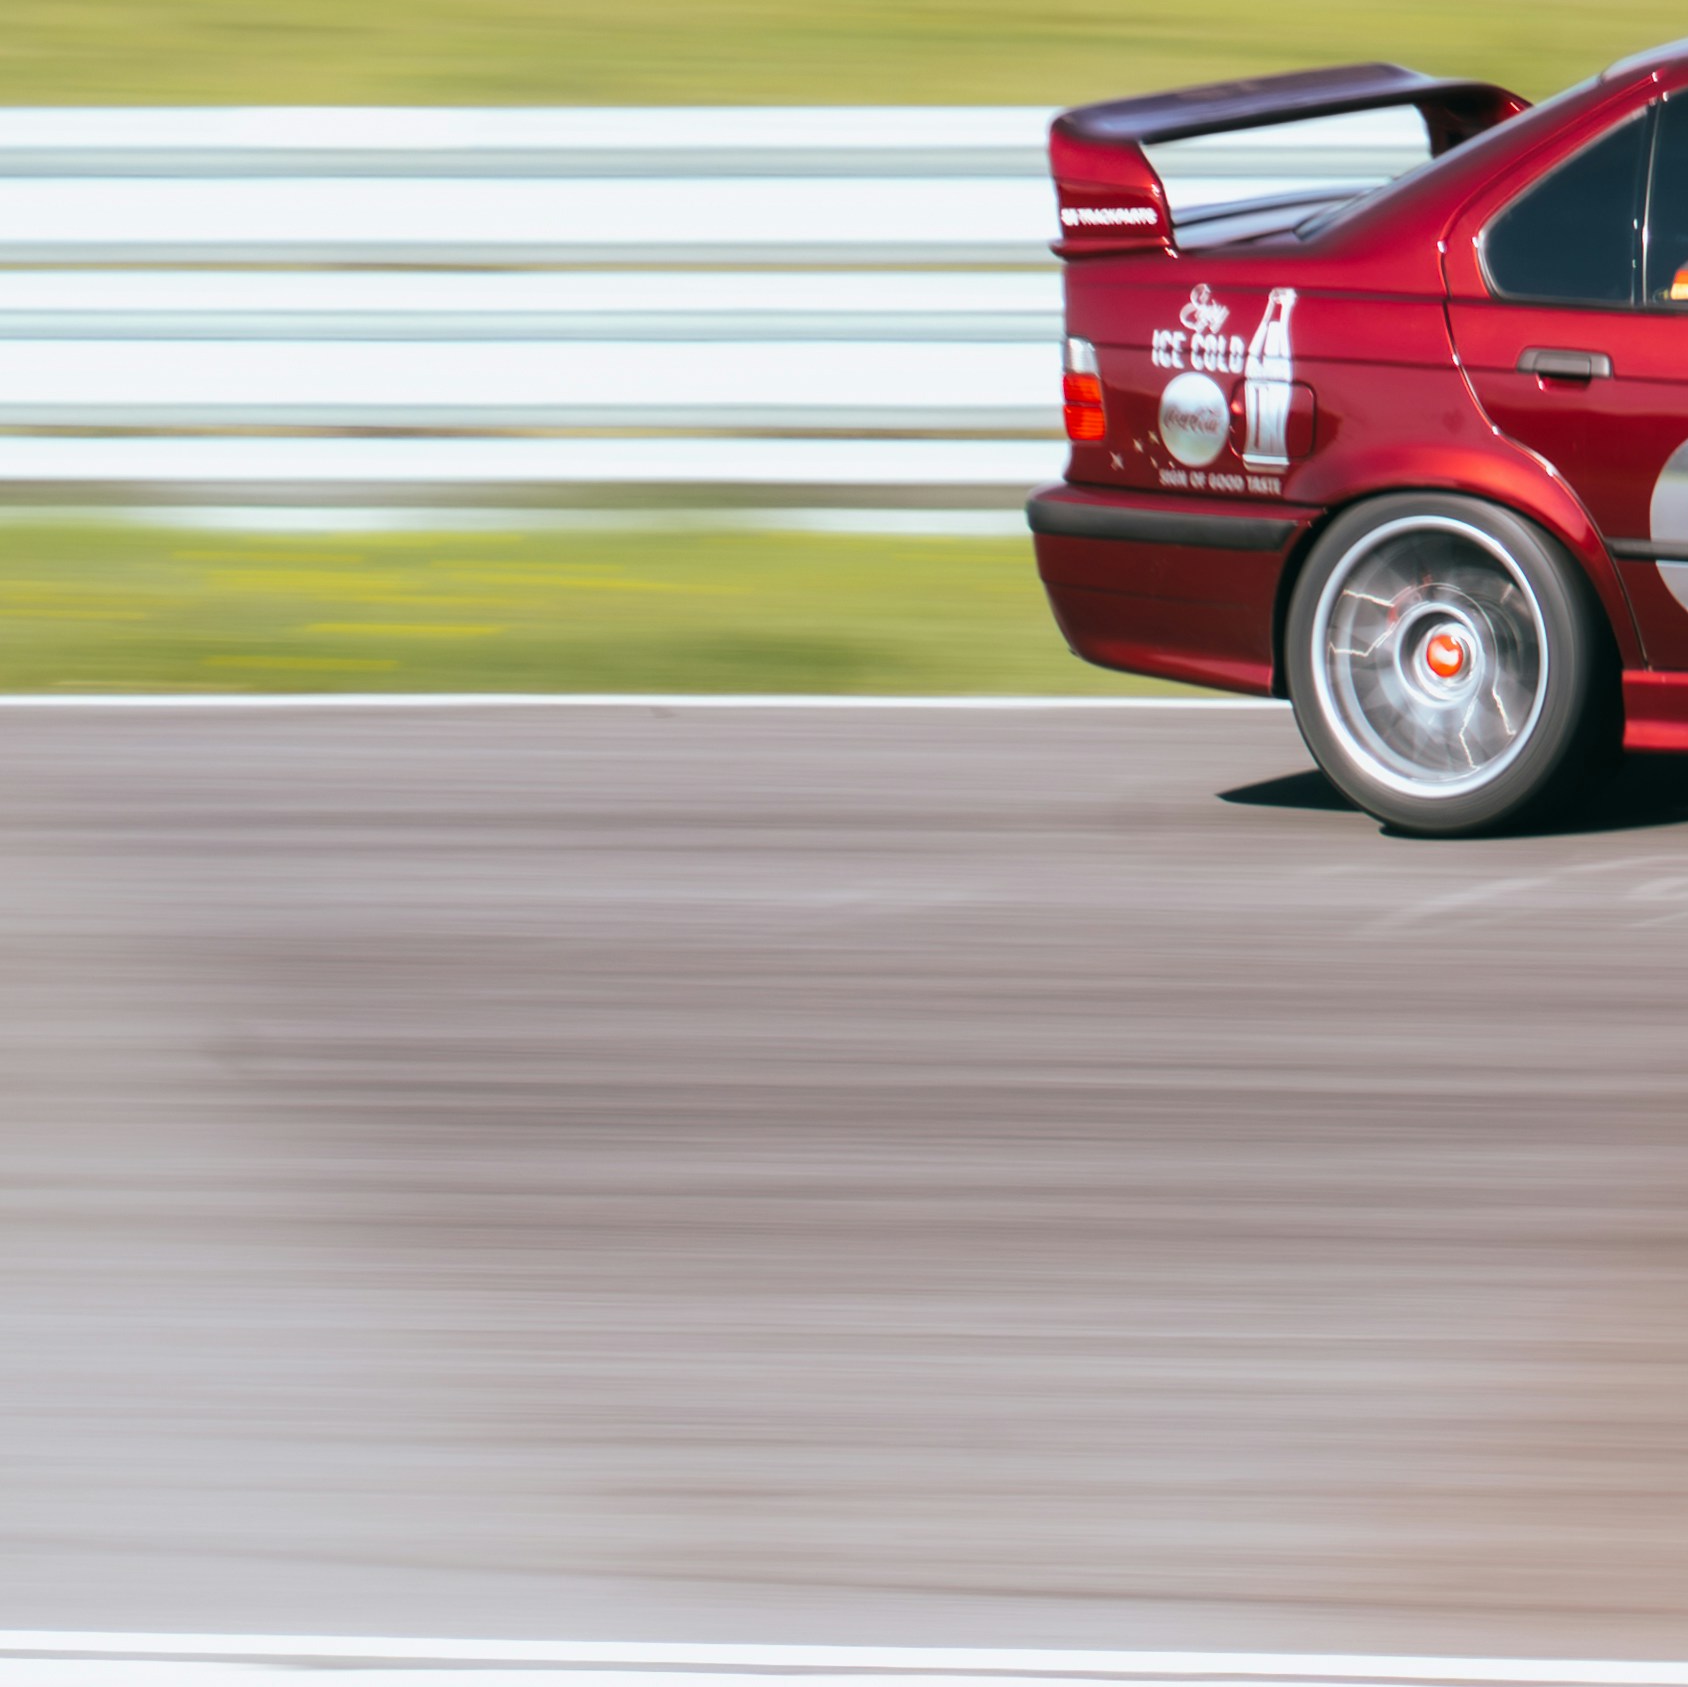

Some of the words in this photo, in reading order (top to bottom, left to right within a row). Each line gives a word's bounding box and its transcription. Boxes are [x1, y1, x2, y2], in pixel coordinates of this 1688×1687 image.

[1151, 328, 1187, 369] ICE
[1191, 332, 1245, 374] COLD
[1207, 472, 1245, 492] GOOD
[1246, 475, 1281, 495] TASTE
